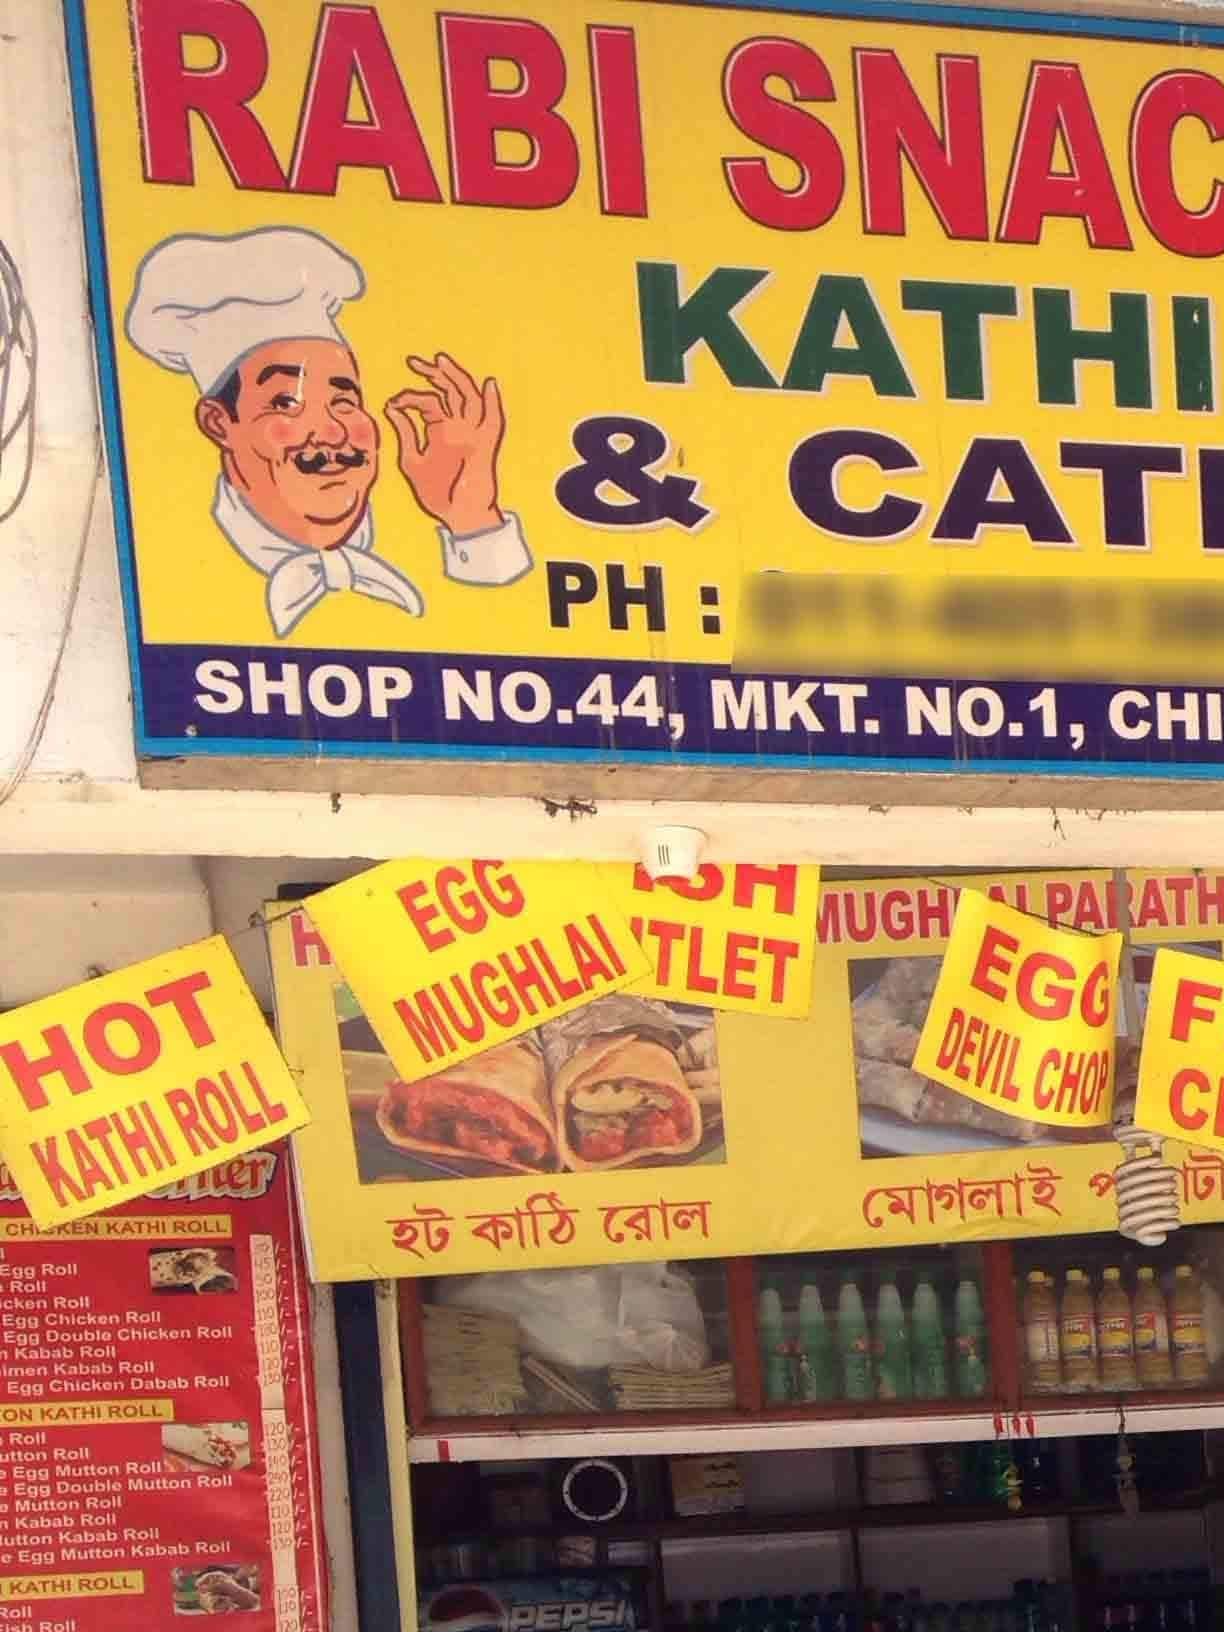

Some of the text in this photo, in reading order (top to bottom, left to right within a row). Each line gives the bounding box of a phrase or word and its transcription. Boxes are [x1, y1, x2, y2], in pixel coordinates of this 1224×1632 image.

[131, 0, 648, 217] RABI
[637, 261, 1214, 411] KATHI
[554, 415, 713, 532] &
[195, 659, 413, 722] SHOP
[443, 666, 685, 737] NO.44,
[710, 679, 880, 735] MKT.
[906, 686, 1083, 751] NO.1,
[395, 859, 526, 953] EGG
[393, 913, 627, 1063] MUGHLAI
[968, 927, 1111, 1028] EGG
[3, 970, 213, 1113] HOT
[937, 1006, 1109, 1118] DEVIL CHOP
[30, 1061, 288, 1209] KATHI ROLL
[105, 1221, 166, 1234] KATHI
[175, 1220, 227, 1233] ROLL
[386, 1192, 712, 1260] হট কাঠি রোল
[862, 1161, 1064, 1228] মোগলাই
[42, 1263, 77, 1275] Roll
[2, 1311, 160, 1329] Egg Chicken Roll
[4, 1326, 231, 1346] Egg Double Chicken Roll
[14, 1345, 116, 1360] Kabab Roll
[8, 1375, 229, 1396] Egg Chicken Dabab Roll
[13, 1461, 161, 1481] Egg Mutton Roll
[11, 1576, 135, 1595] KATHI ROLL
[18, 1540, 230, 1565] Egg Mutton Kabab Roll
[511, 1600, 625, 1632] PEPSI
